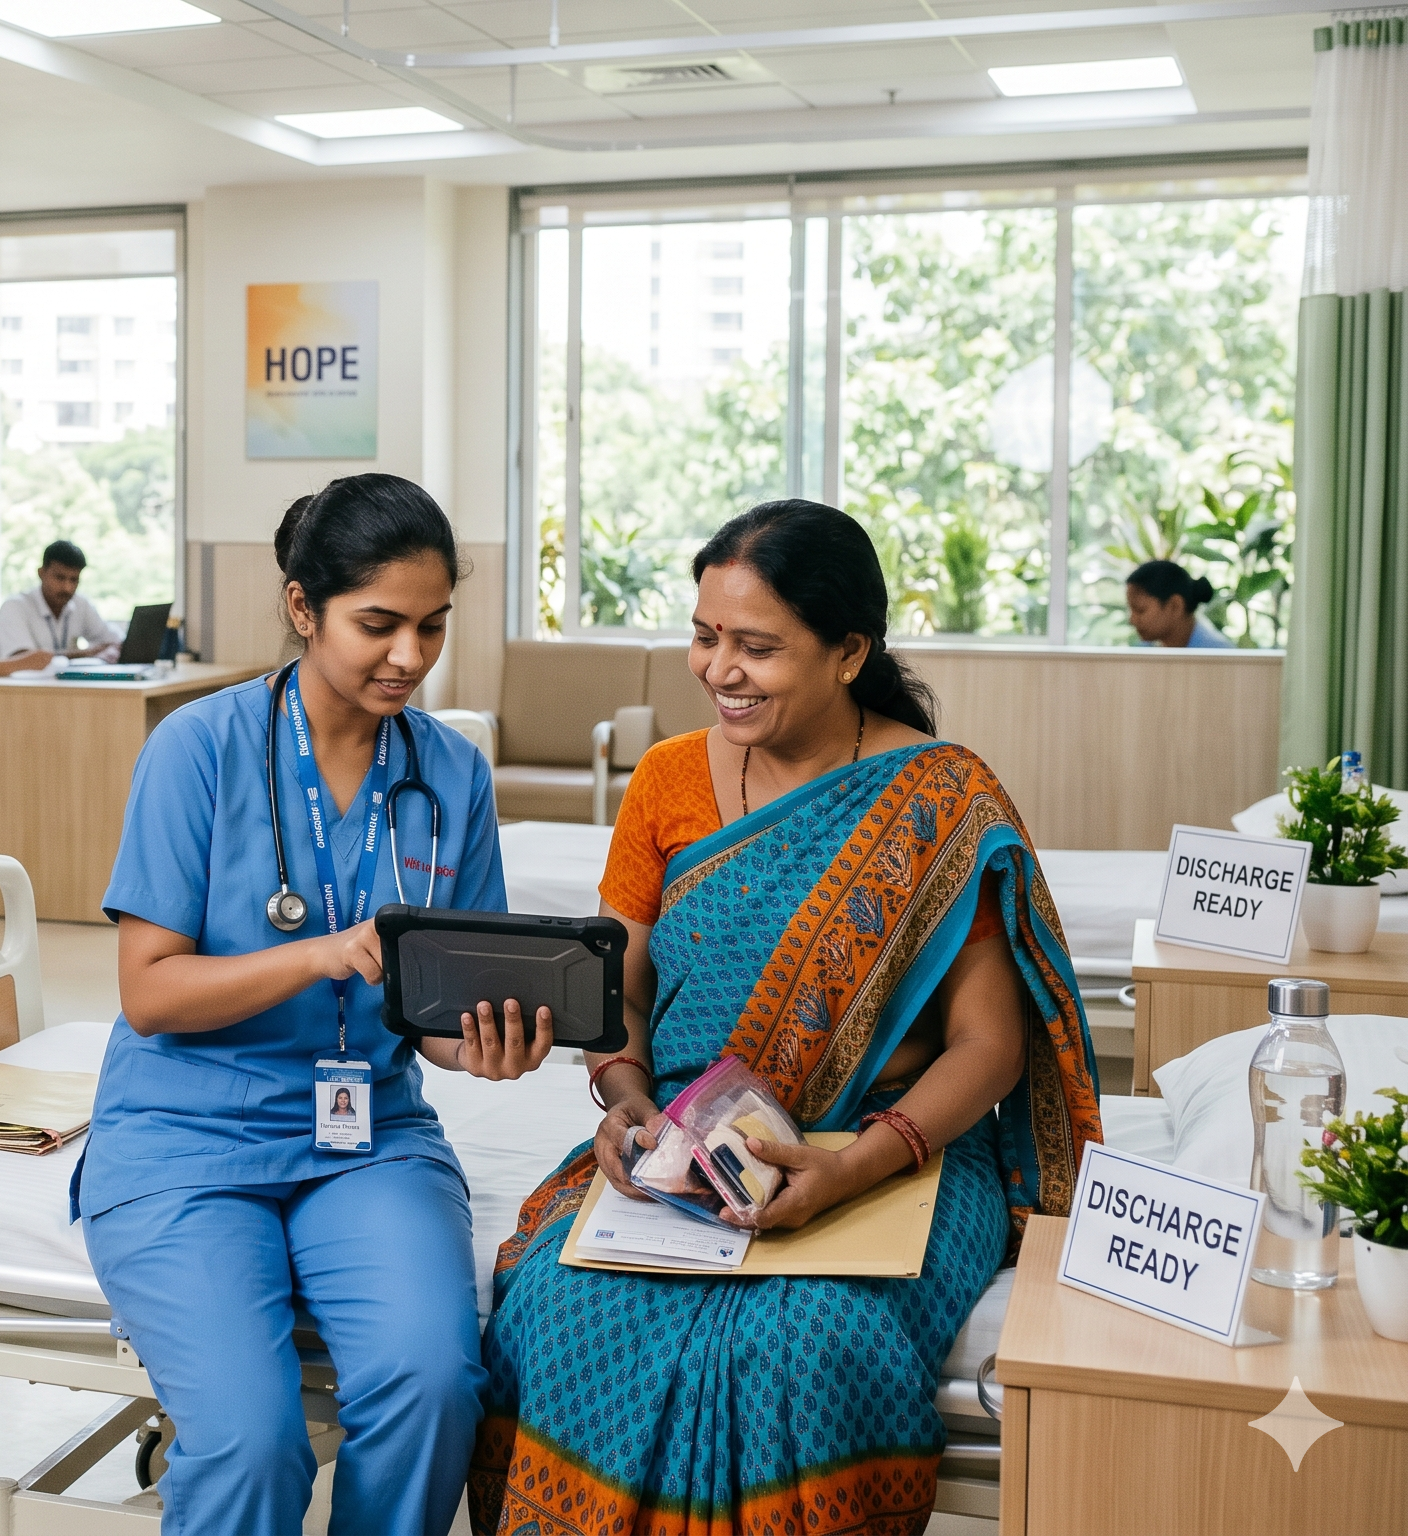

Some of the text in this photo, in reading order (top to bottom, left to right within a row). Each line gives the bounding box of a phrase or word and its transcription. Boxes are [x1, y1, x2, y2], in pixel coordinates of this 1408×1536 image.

[265, 346, 359, 382] HOPE
[1176, 855, 1294, 893] DISCHARGE
[1193, 890, 1263, 920] READY
[1087, 1179, 1243, 1257] DISCHARGE
[1107, 1234, 1200, 1291] READY
